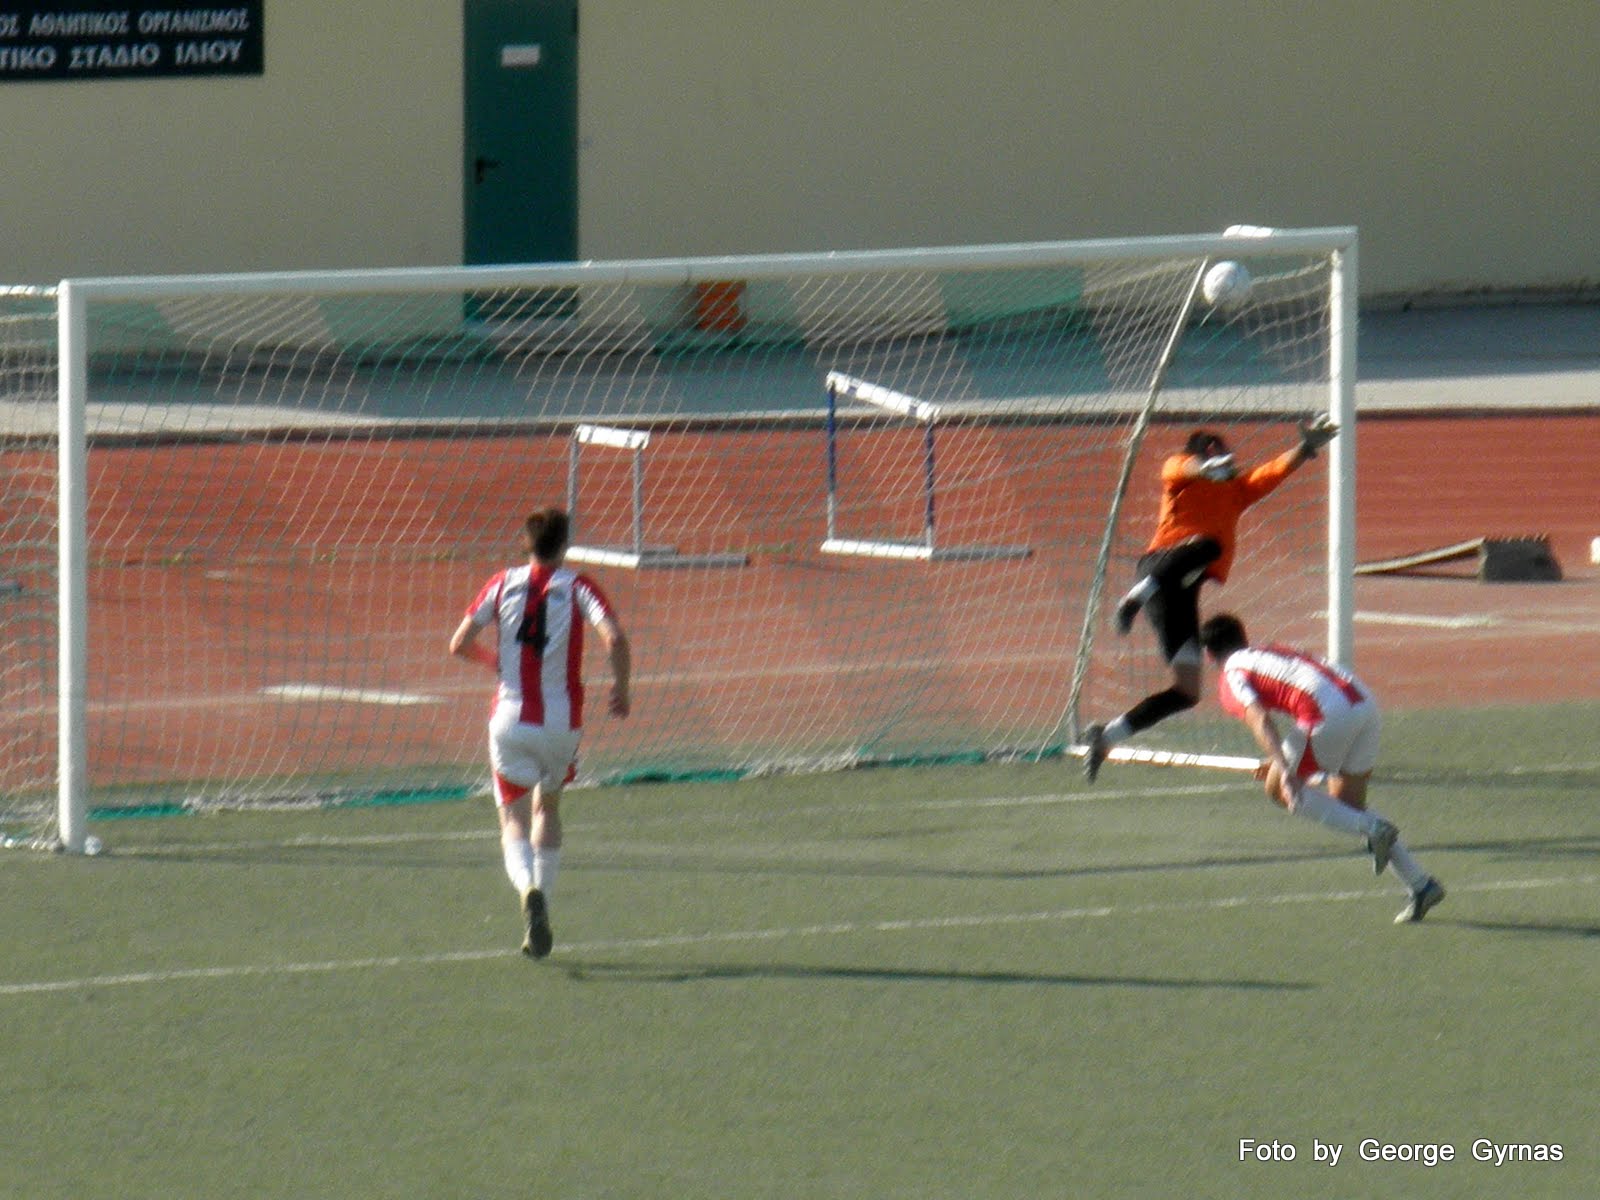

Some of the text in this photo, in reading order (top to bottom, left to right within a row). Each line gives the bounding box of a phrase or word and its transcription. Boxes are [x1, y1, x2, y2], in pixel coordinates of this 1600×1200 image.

[29, 12, 130, 36] ΑΘΛΗΤΙΚΟΣ
[138, 8, 249, 33] ΟΡΓΑΝΙΣΜΟΣ
[69, 43, 160, 69] ΣΤΑΔΙΟ
[175, 40, 244, 65] ΙΛΙΟΥ
[516, 600, 549, 657] 4
